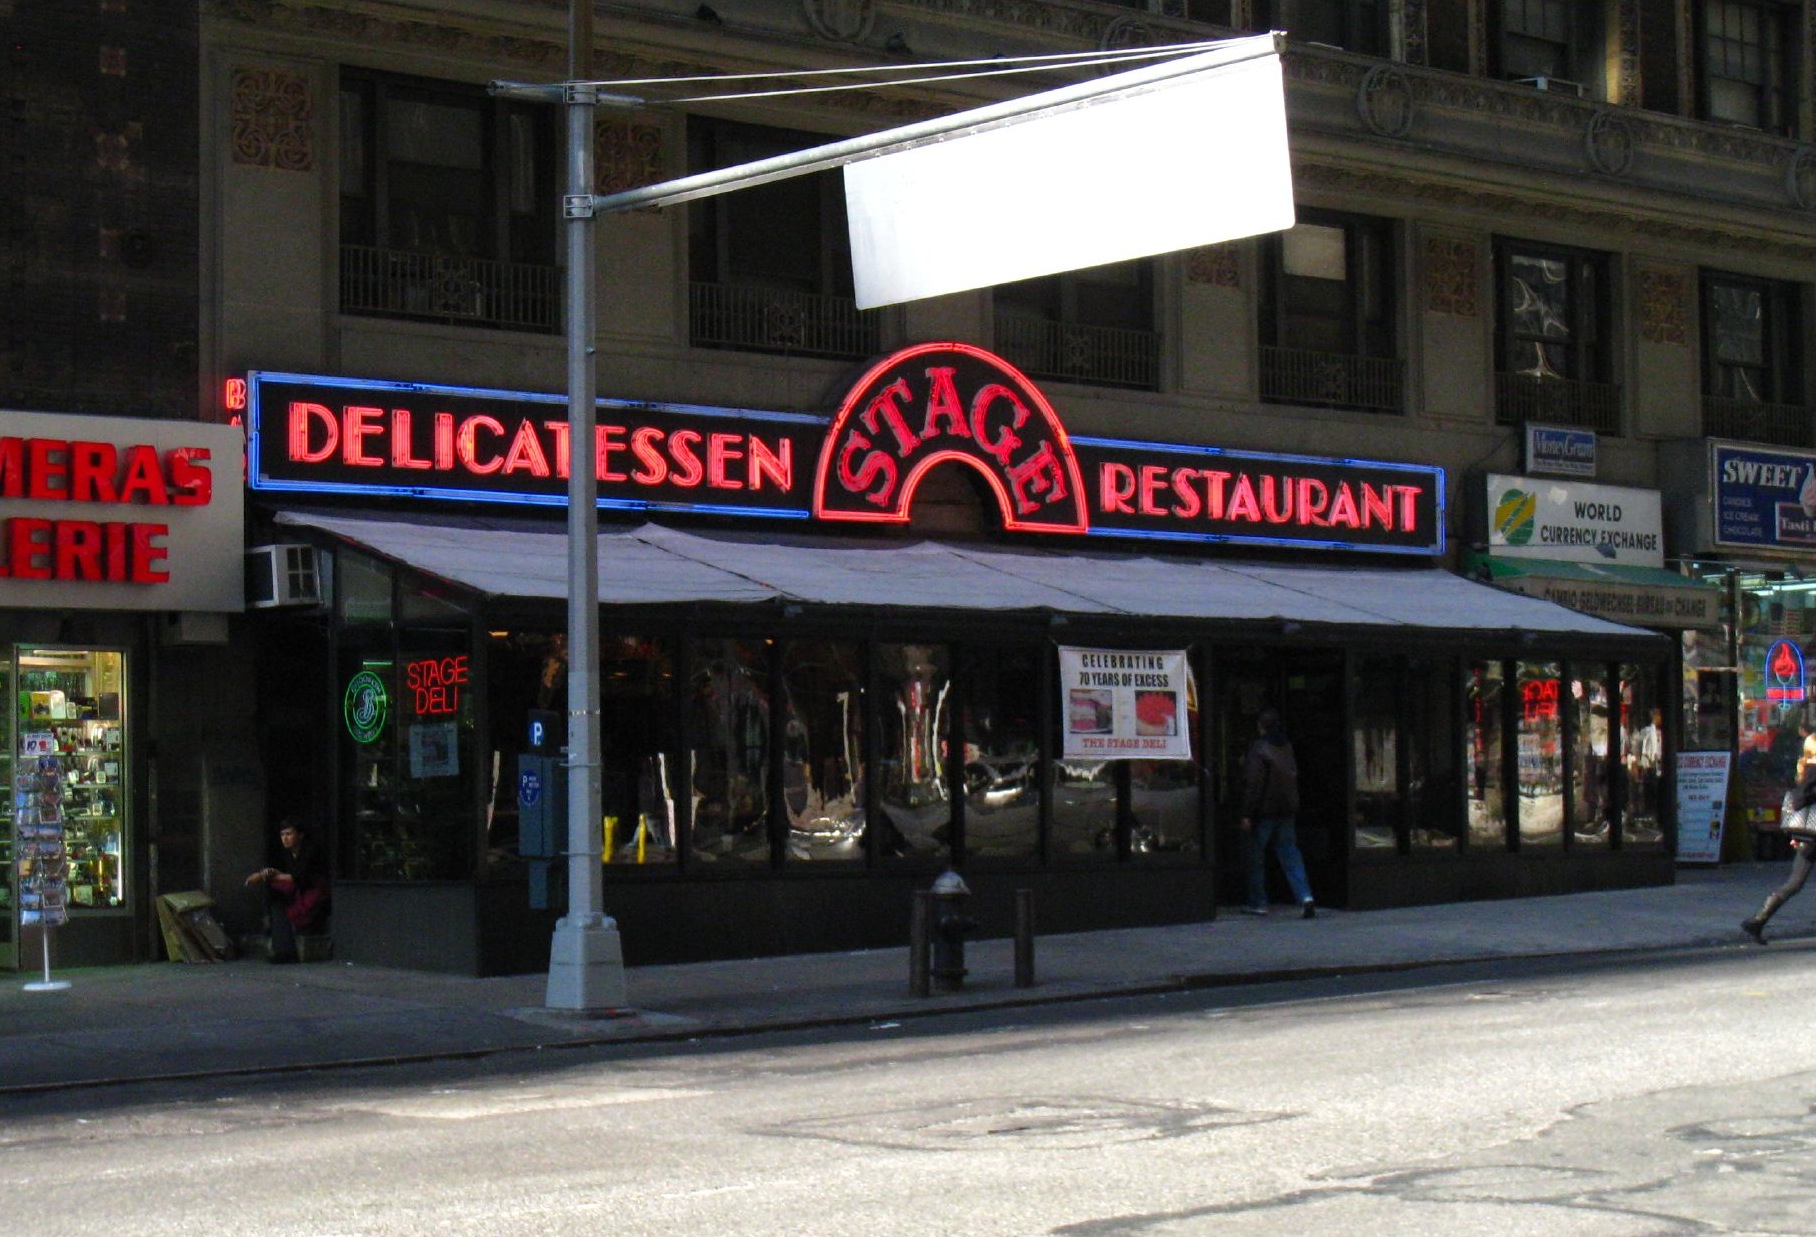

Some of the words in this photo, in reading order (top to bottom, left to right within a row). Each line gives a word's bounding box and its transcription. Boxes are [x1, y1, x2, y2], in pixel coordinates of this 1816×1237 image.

[288, 401, 793, 492] DELICATESSEN
[837, 366, 1067, 515] STAGE
[1723, 459, 1802, 489] SWEET
[1101, 462, 1422, 533] RESTAURANT
[1574, 501, 1622, 522] WORLD
[0, 517, 169, 583] ERIE
[1540, 525, 1597, 545] CURRENCY
[1601, 531, 1657, 550] EXCHANGE
[407, 656, 467, 689] STAGE
[1082, 654, 1164, 670] CELEBRATING
[1080, 672, 1090, 685] 70
[1092, 673, 1119, 686] YEARS
[1122, 673, 1132, 686] OF
[1135, 674, 1169, 687] EXCESS
[416, 687, 457, 714] DELI
[1082, 738, 1105, 748] THE
[1107, 738, 1139, 748] STAGE
[1142, 738, 1168, 749] DELI
